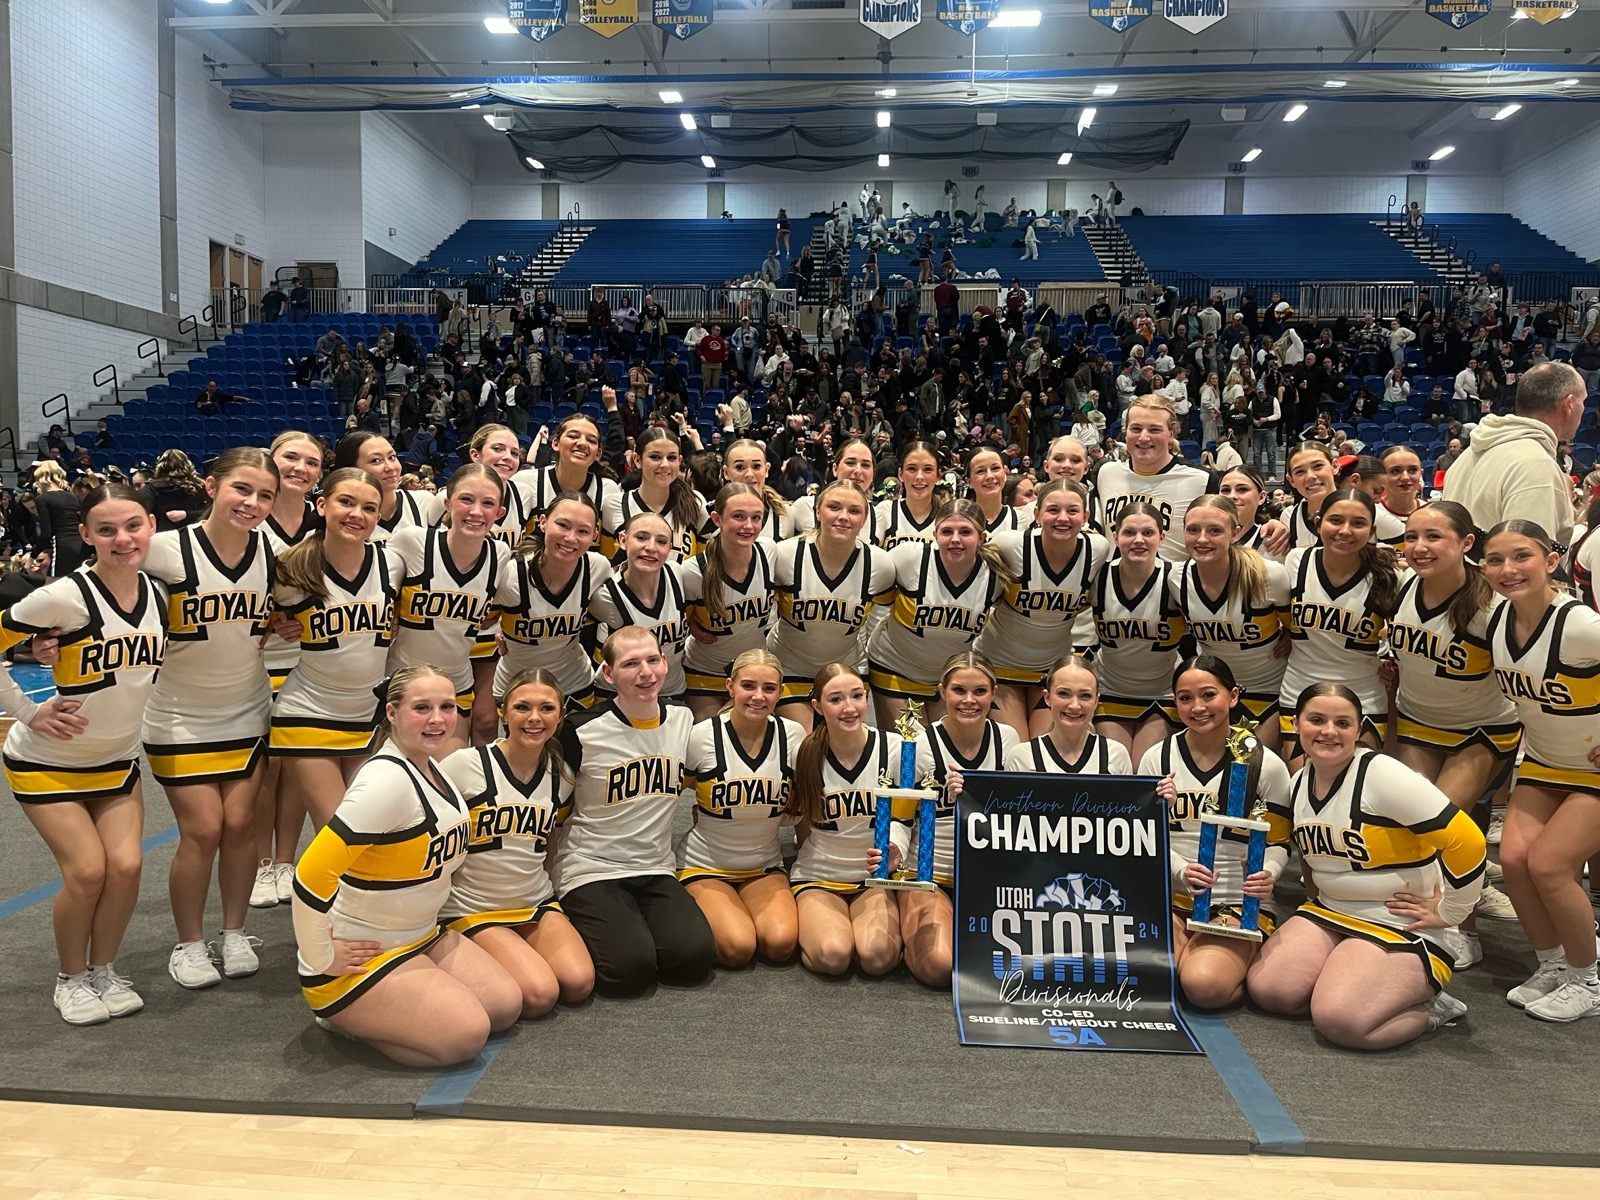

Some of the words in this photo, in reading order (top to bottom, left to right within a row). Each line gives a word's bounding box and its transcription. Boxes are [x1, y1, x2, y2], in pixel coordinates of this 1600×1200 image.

[656, 15, 709, 24] VOLLEYBALL
[862, 1, 920, 23] CHAMPIONS
[1091, 7, 1149, 17] BASKETBALL
[1166, 0, 1225, 17] CHAMPIONS
[1428, 4, 1488, 13] BASKETBALL
[791, 597, 865, 627] ROYALS
[913, 604, 986, 634] ROYALS
[1291, 601, 1376, 641] ROYALS
[1097, 618, 1172, 642] ROYALS
[1494, 667, 1574, 706] OYALS
[604, 754, 684, 807] ROYALS
[710, 777, 792, 810] ROYALS
[825, 788, 876, 821] OYAL
[983, 789, 1064, 815] Northern
[1072, 791, 1142, 816] Division
[967, 812, 1157, 857] CHAMPION
[996, 886, 1033, 909] UTAH
[991, 909, 1138, 986] STATE
[999, 969, 1142, 1012] Divisionals
[968, 1015, 1117, 1029] SIDELINE/TIMEOUT
[1122, 1021, 1178, 1032] CHEER
[1041, 1008, 1094, 1019] CO-ED
[1048, 1026, 1107, 1046] 5A
